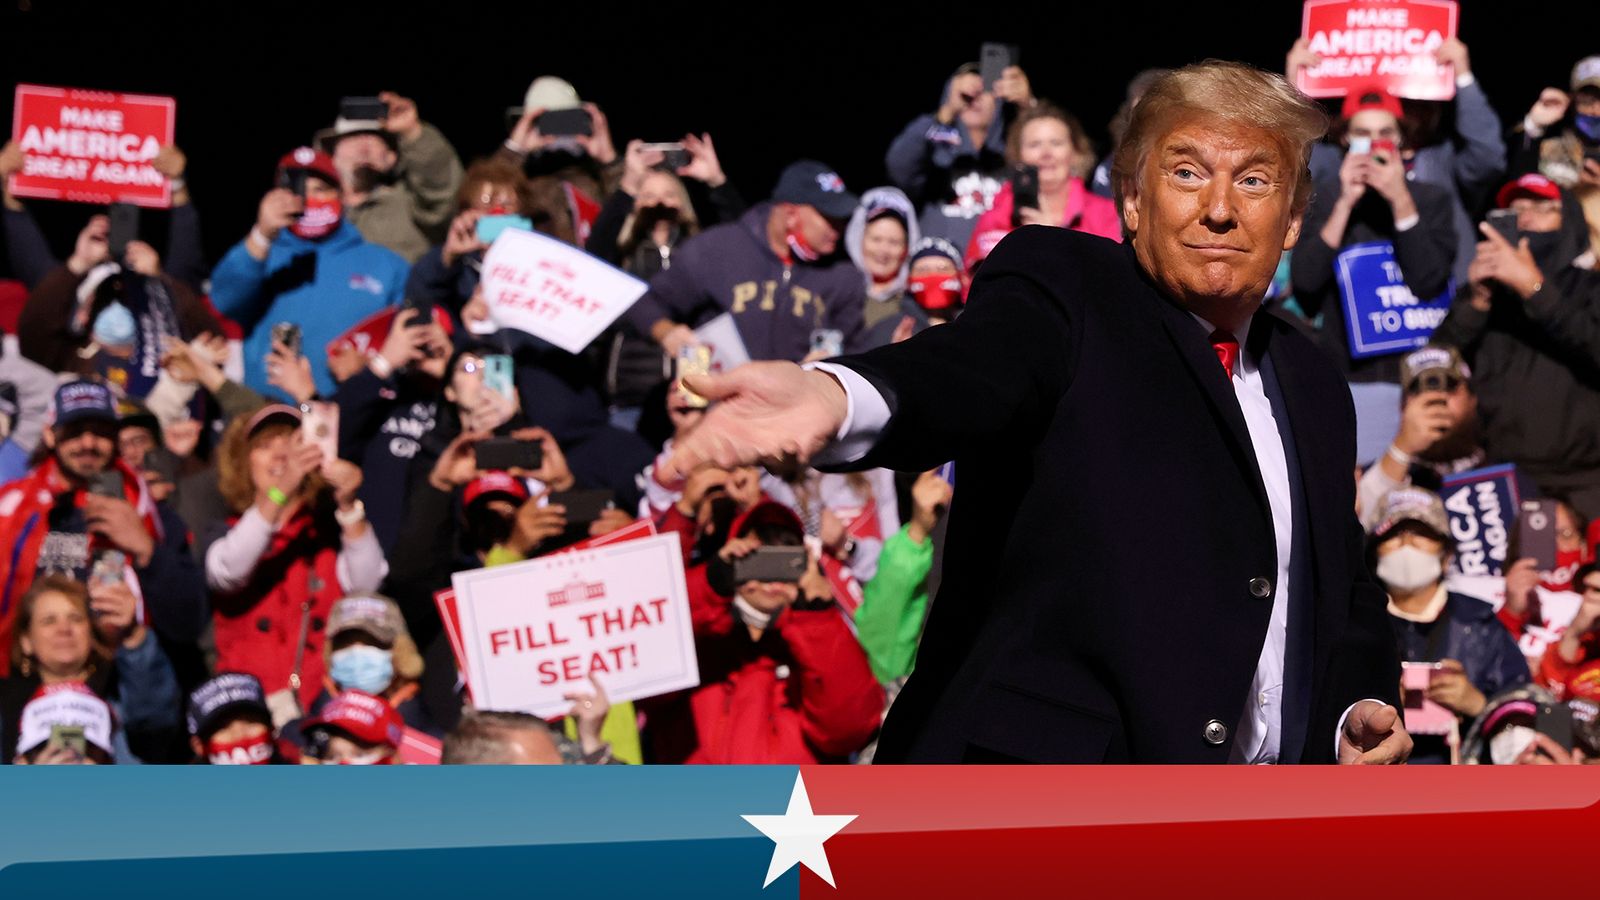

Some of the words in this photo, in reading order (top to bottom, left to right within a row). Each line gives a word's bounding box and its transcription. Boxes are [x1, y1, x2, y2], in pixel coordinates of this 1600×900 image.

[1346, 8, 1408, 28] MAKE
[1308, 28, 1443, 56] AMERICA
[60, 105, 124, 133] MAKE
[20, 124, 160, 163] AMERICA
[491, 263, 530, 286] FILL
[541, 277, 603, 316] THAT
[1367, 309, 1402, 334] TO
[489, 622, 569, 656] FILL
[578, 597, 668, 638] THAT
[536, 643, 640, 687] SEAT!
